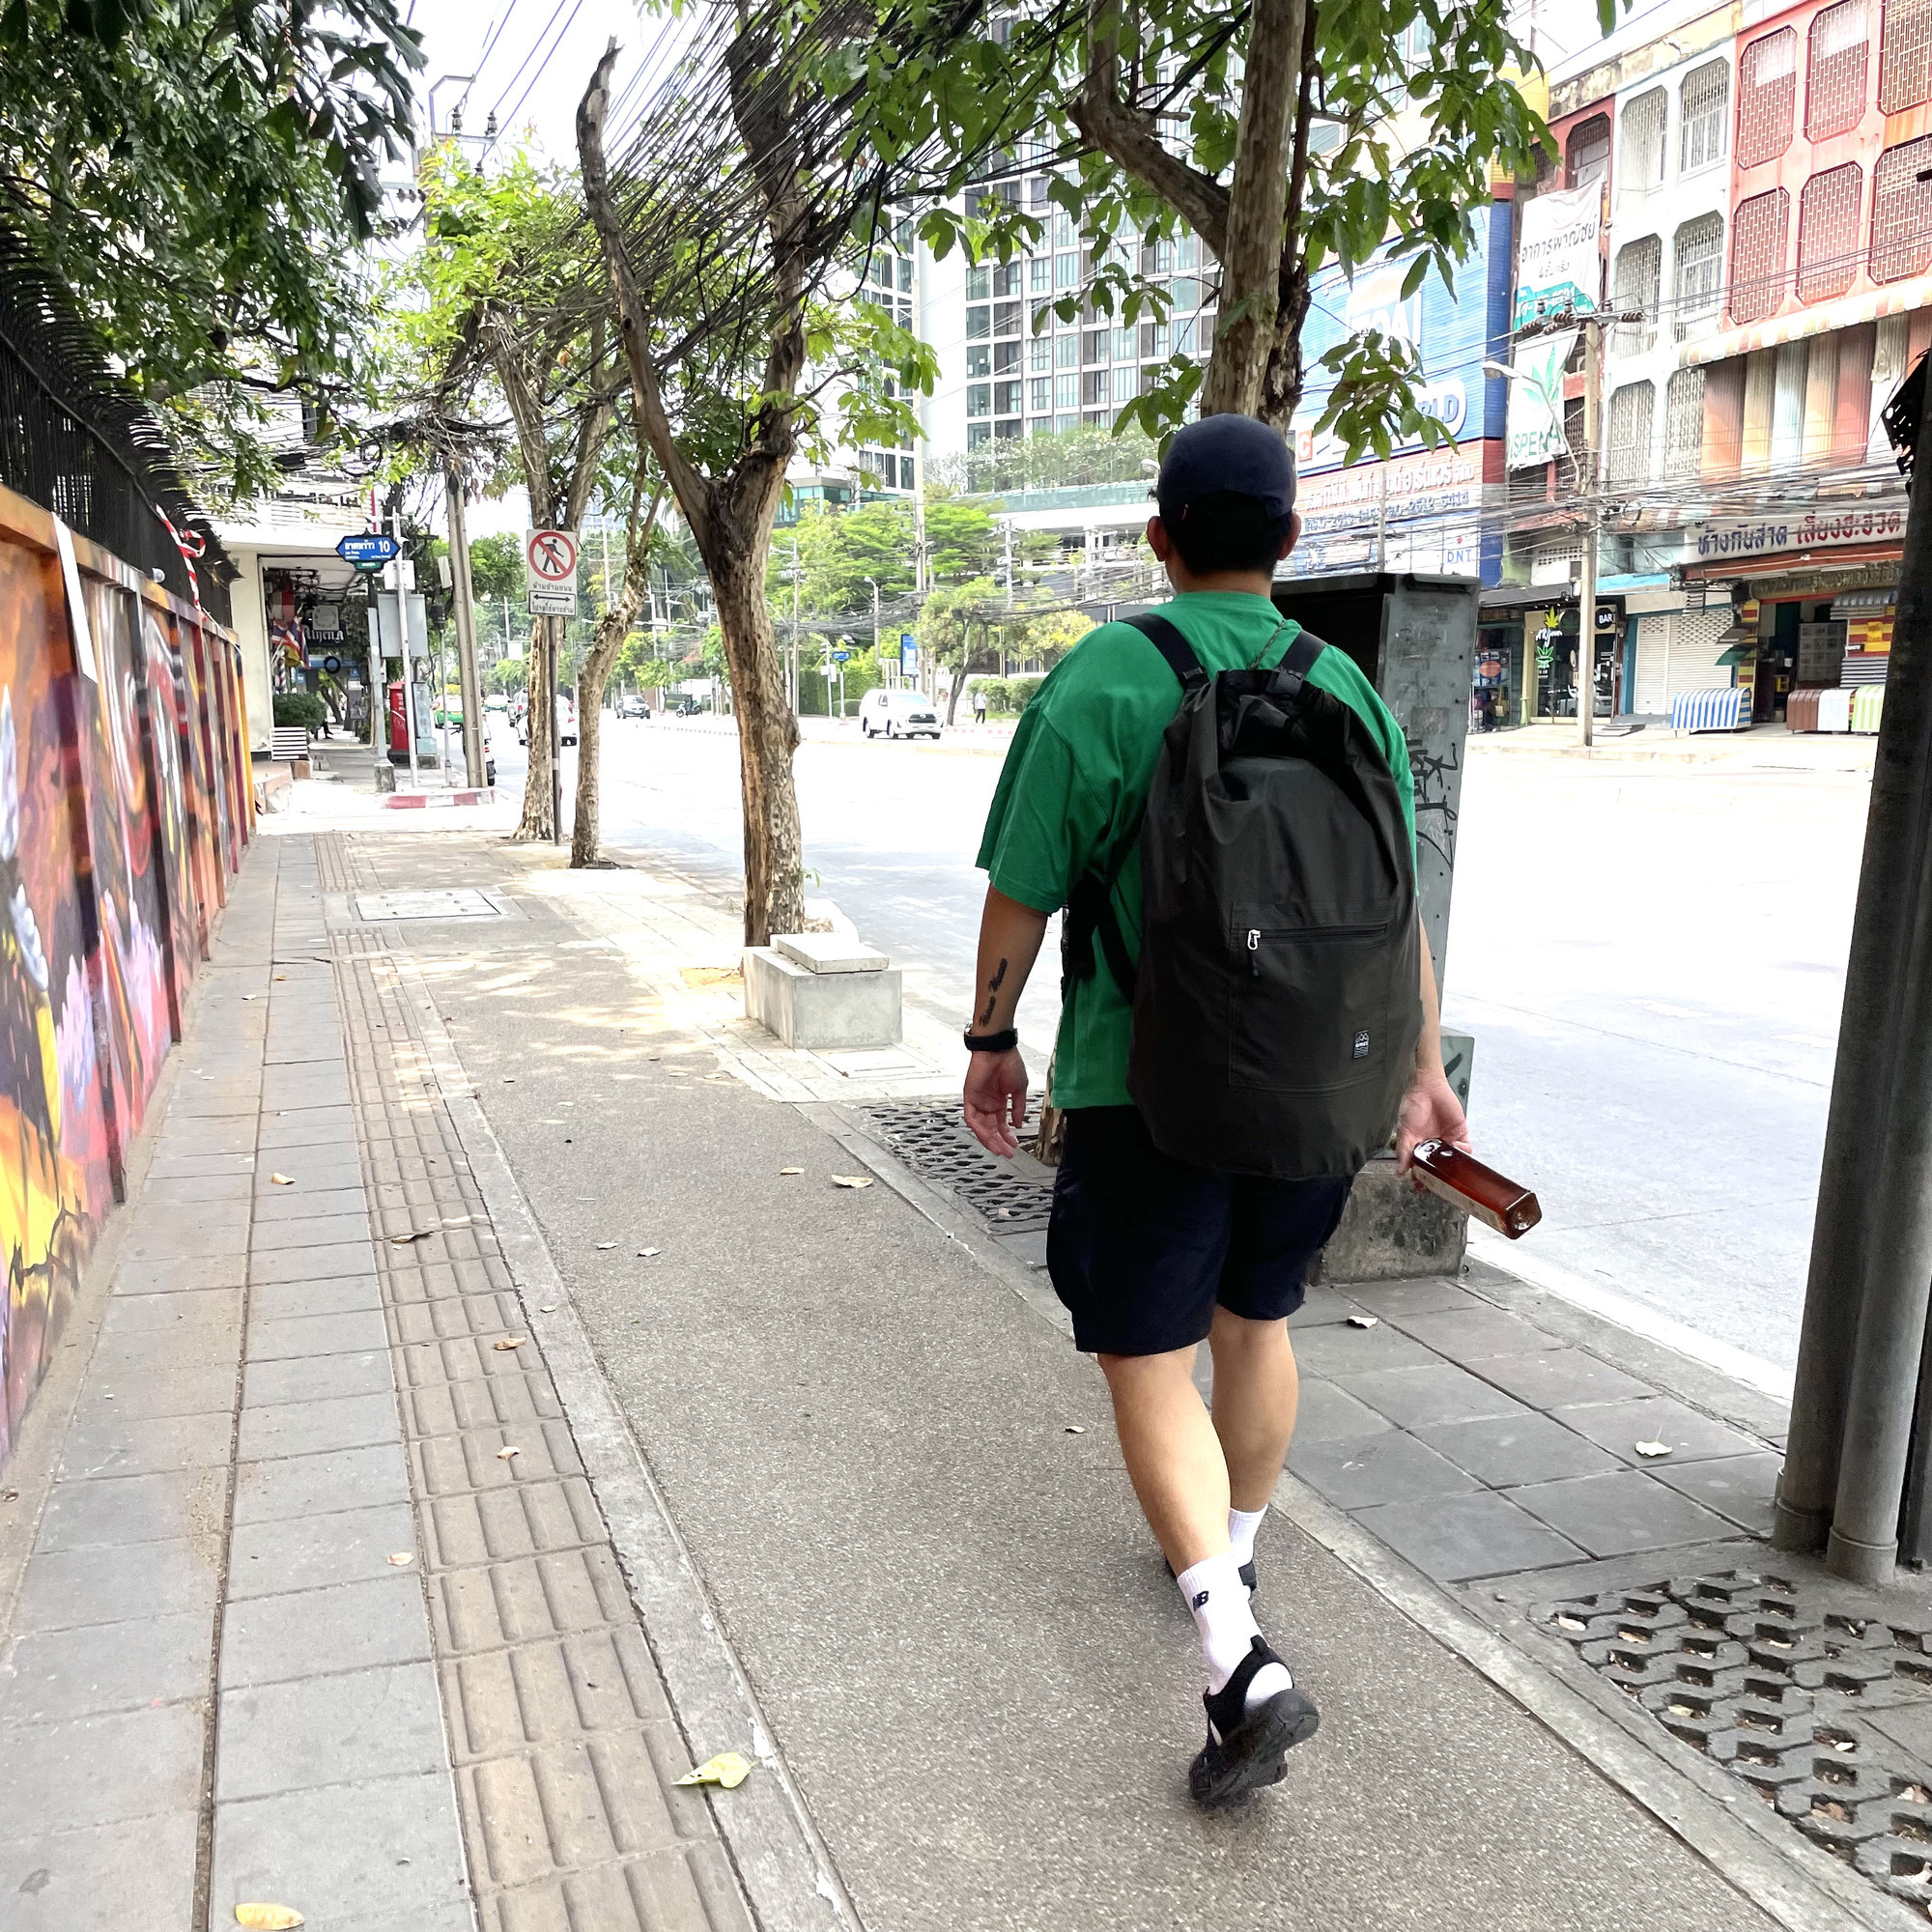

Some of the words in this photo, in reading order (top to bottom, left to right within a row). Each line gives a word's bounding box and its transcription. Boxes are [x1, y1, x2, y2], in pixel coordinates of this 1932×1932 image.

[1697, 523, 1788, 555] ห้างกันสาด
[378, 540, 391, 554] 10
[1447, 549, 1472, 563] DNT
[1599, 612, 1614, 624] BAR
